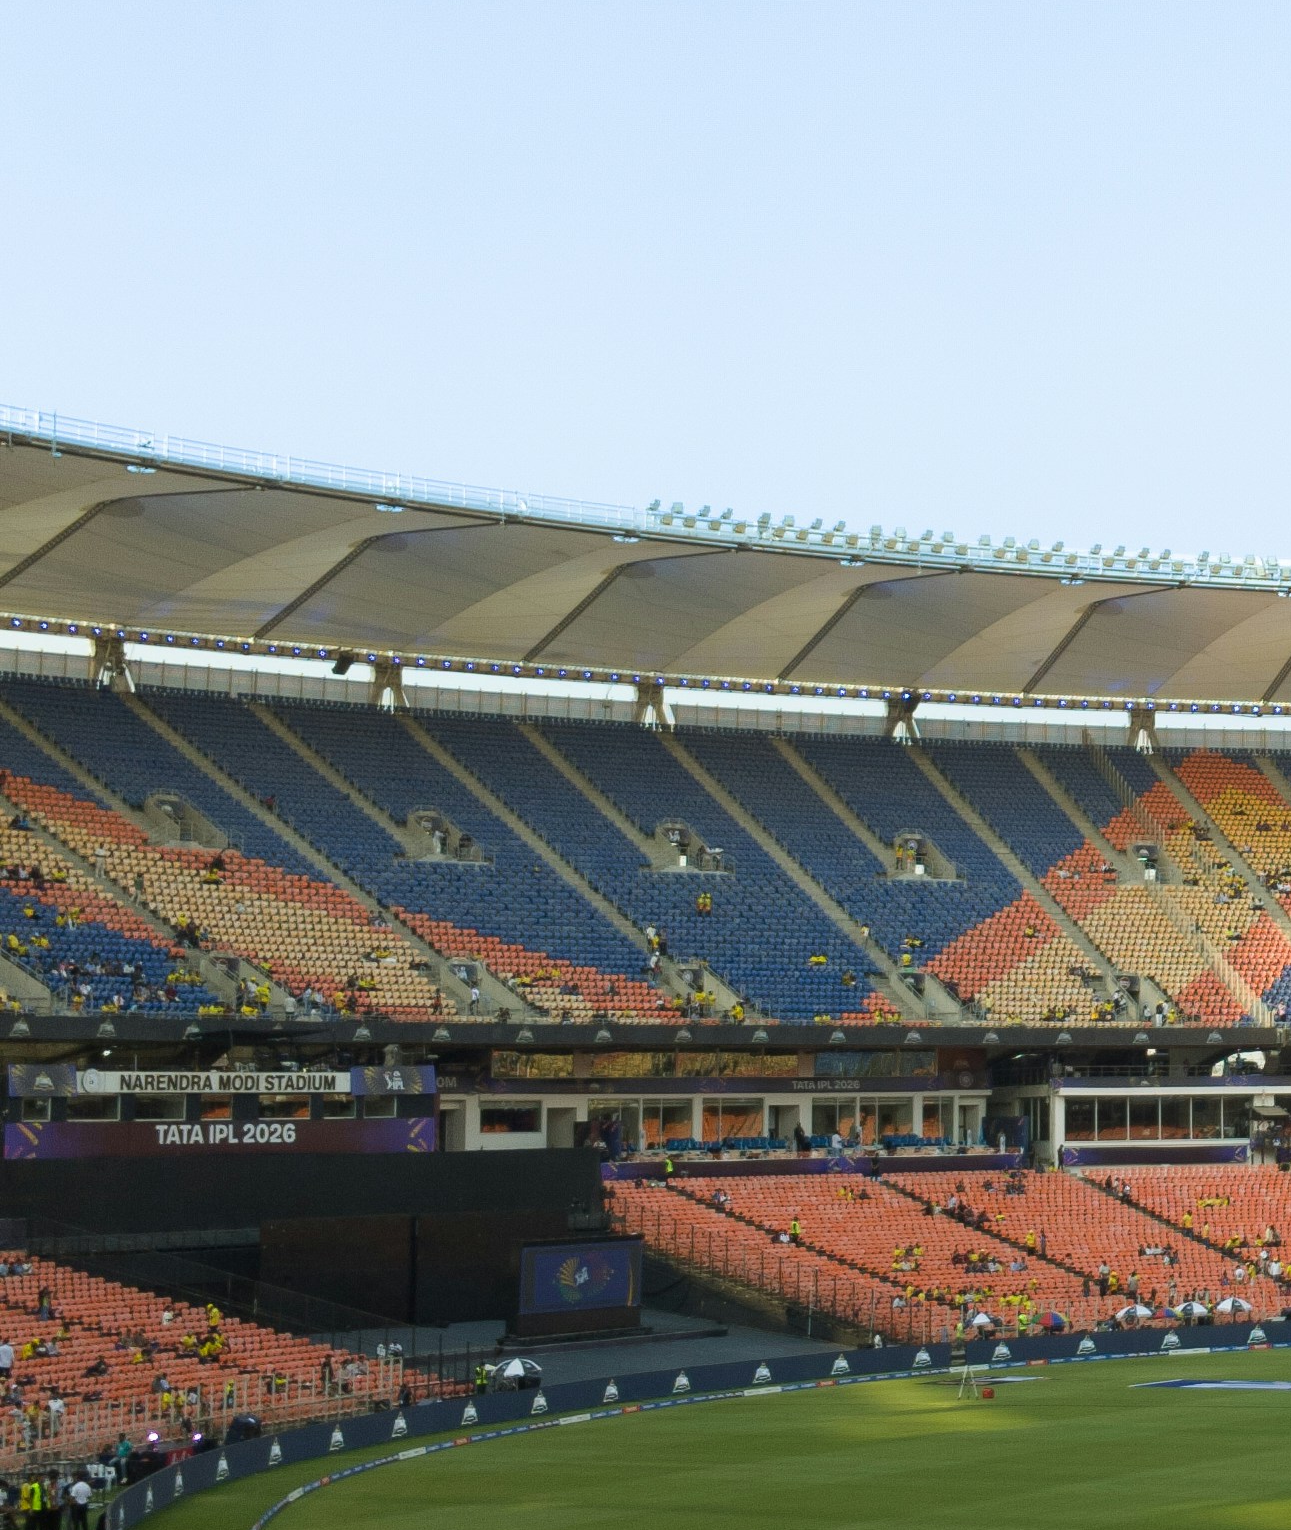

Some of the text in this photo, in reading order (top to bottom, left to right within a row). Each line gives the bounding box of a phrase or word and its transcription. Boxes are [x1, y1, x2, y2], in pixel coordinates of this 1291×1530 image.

[120, 1075, 337, 1091] NARENDRA MODI STADIUM
[792, 1080, 861, 1090] TATA IPL 2026
[156, 1123, 296, 1145] TATA IPL 2026
